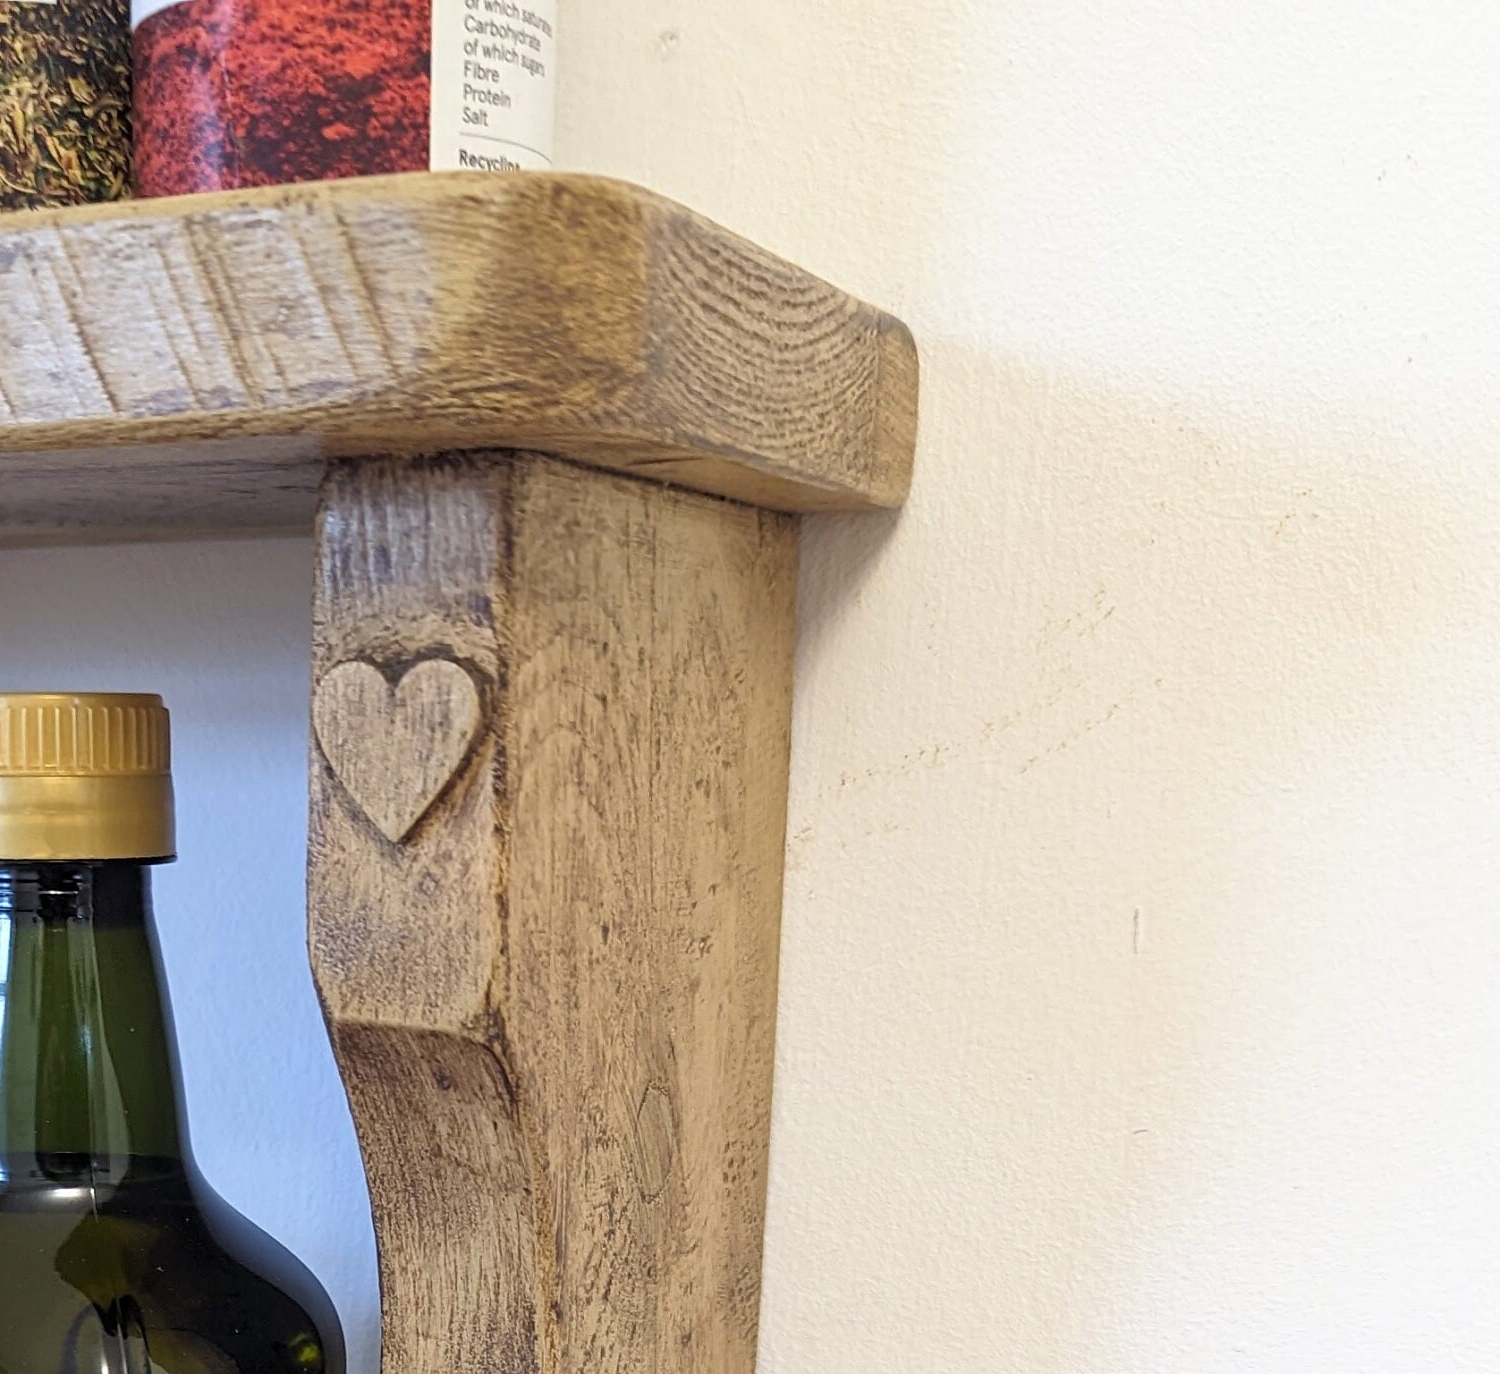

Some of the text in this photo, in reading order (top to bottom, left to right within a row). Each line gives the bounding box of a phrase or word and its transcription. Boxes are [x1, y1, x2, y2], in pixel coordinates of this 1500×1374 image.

[464, 14, 541, 52] Carbohydrate
[463, 38, 479, 55] of
[482, 43, 520, 66] which
[464, 60, 500, 83] Fibre
[463, 83, 512, 109] Protein
[462, 106, 489, 127] Salt
